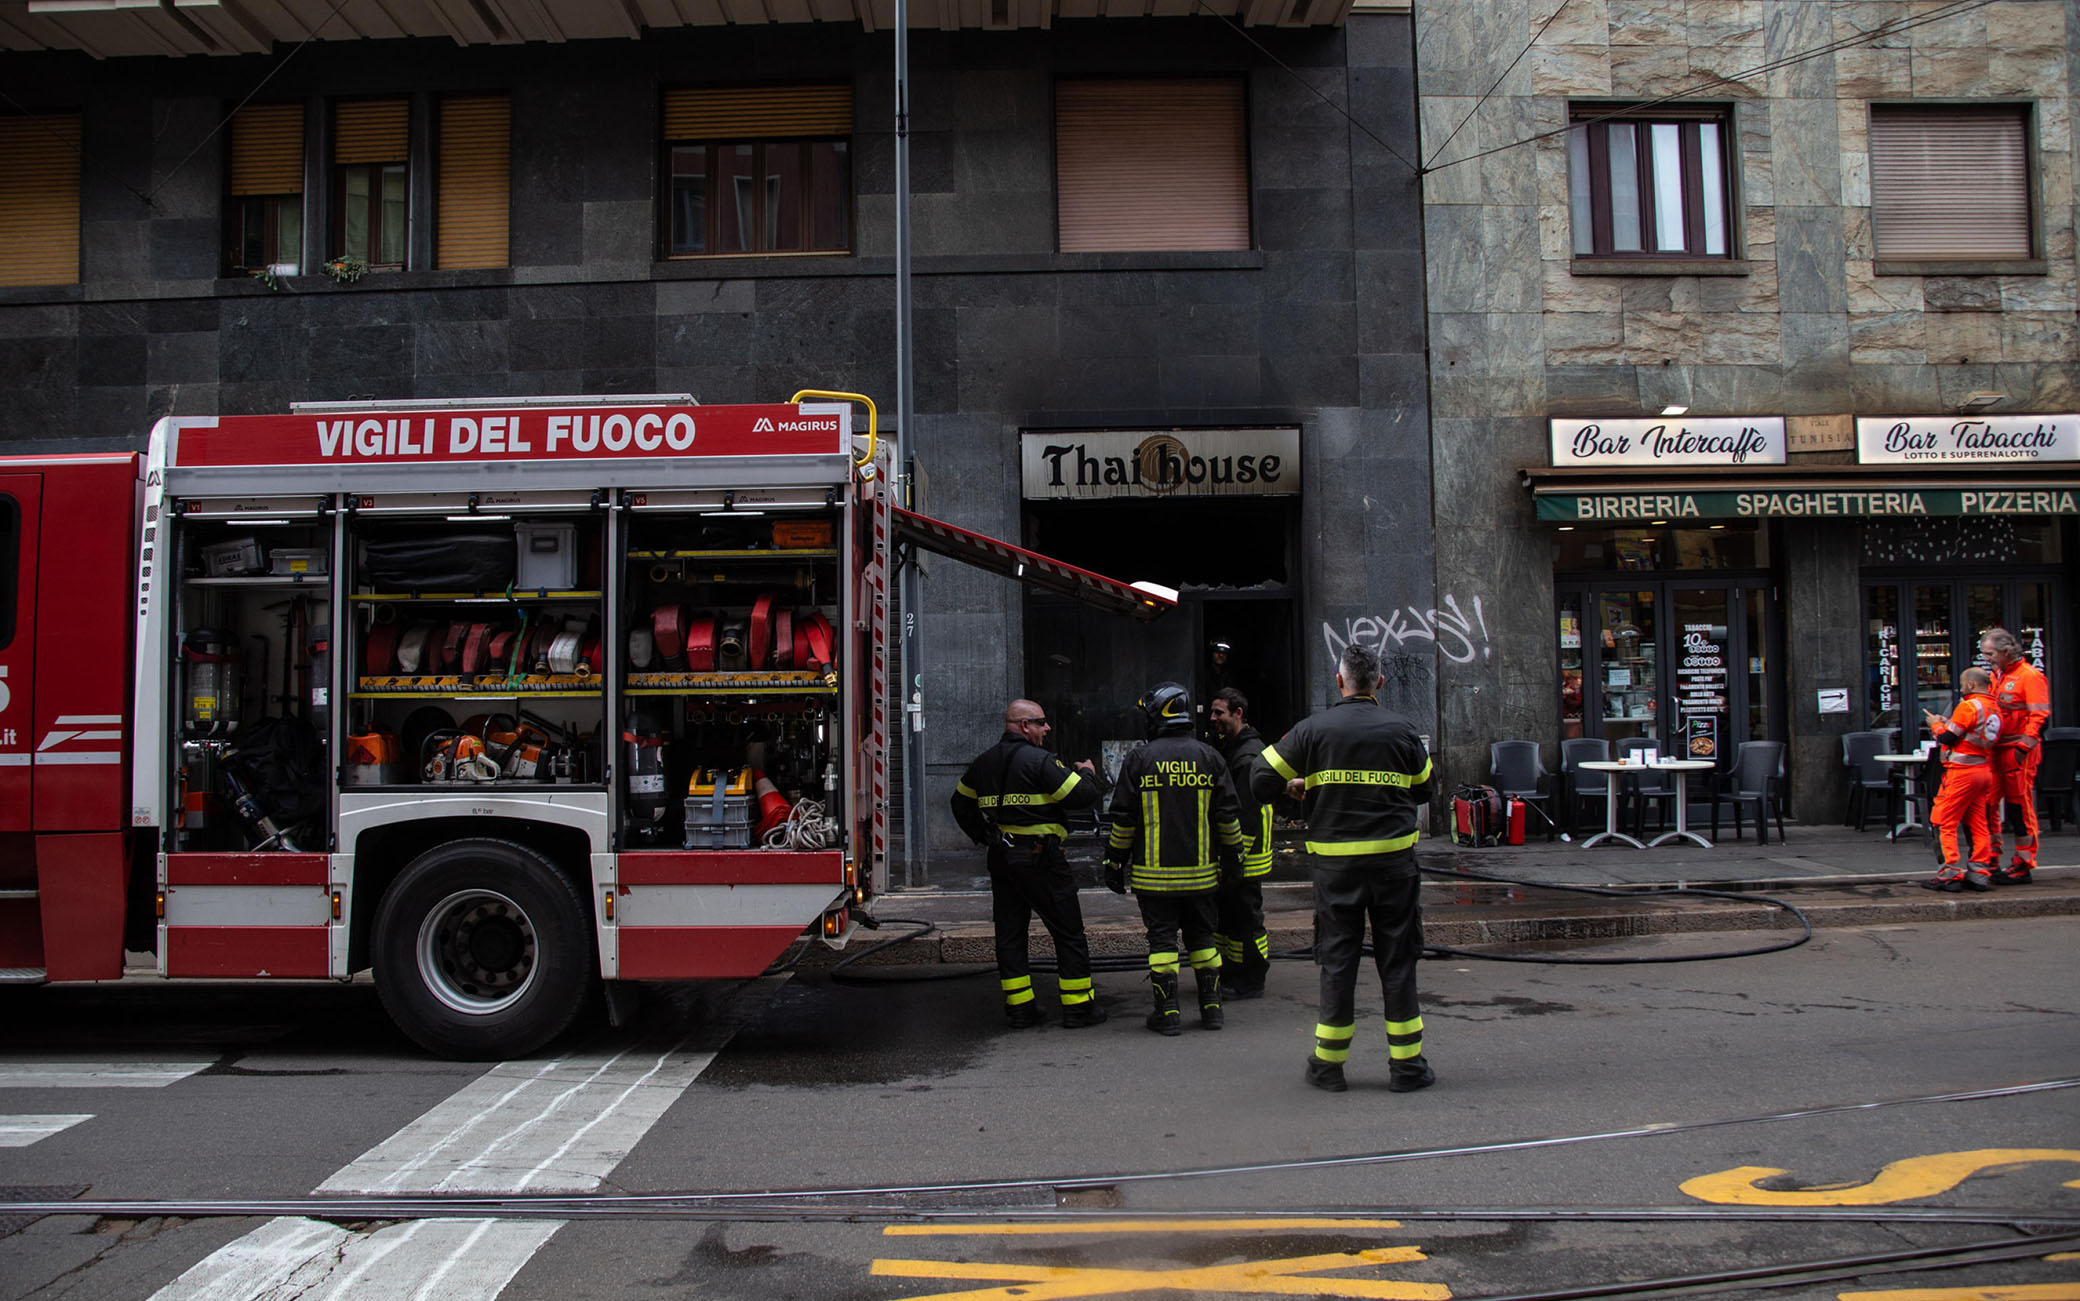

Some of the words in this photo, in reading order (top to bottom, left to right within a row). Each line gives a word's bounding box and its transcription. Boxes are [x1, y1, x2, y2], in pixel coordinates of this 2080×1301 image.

[778, 421, 837, 431] MAGIRUS
[316, 418, 434, 457] VIGILI
[449, 416, 532, 454] DEL
[546, 412, 696, 453] FUOCO
[1790, 432, 1852, 444] TUNISIA
[1884, 421, 1938, 453] Bar
[1950, 420, 2058, 449] Tabacchi
[1572, 424, 1631, 458] Bar
[1640, 425, 1767, 463] Intercaffè
[1904, 452, 1938, 460] LOTTO
[1941, 451, 1947, 459] E
[1949, 450, 2039, 459] SUPERENALOTTO
[1041, 443, 1142, 485] Thai
[1157, 443, 1281, 485] house
[191, 503, 200, 511] V1
[362, 499, 373, 507] V3
[1577, 495, 1700, 519] BIRRERIA
[1736, 492, 1927, 516] SPAGHETTERIA
[1960, 491, 2078, 514] PIZZERIA
[1878, 630, 1892, 711] RICARICHE
[1156, 760, 1197, 774] VIGILI
[1345, 771, 1365, 782] DEL
